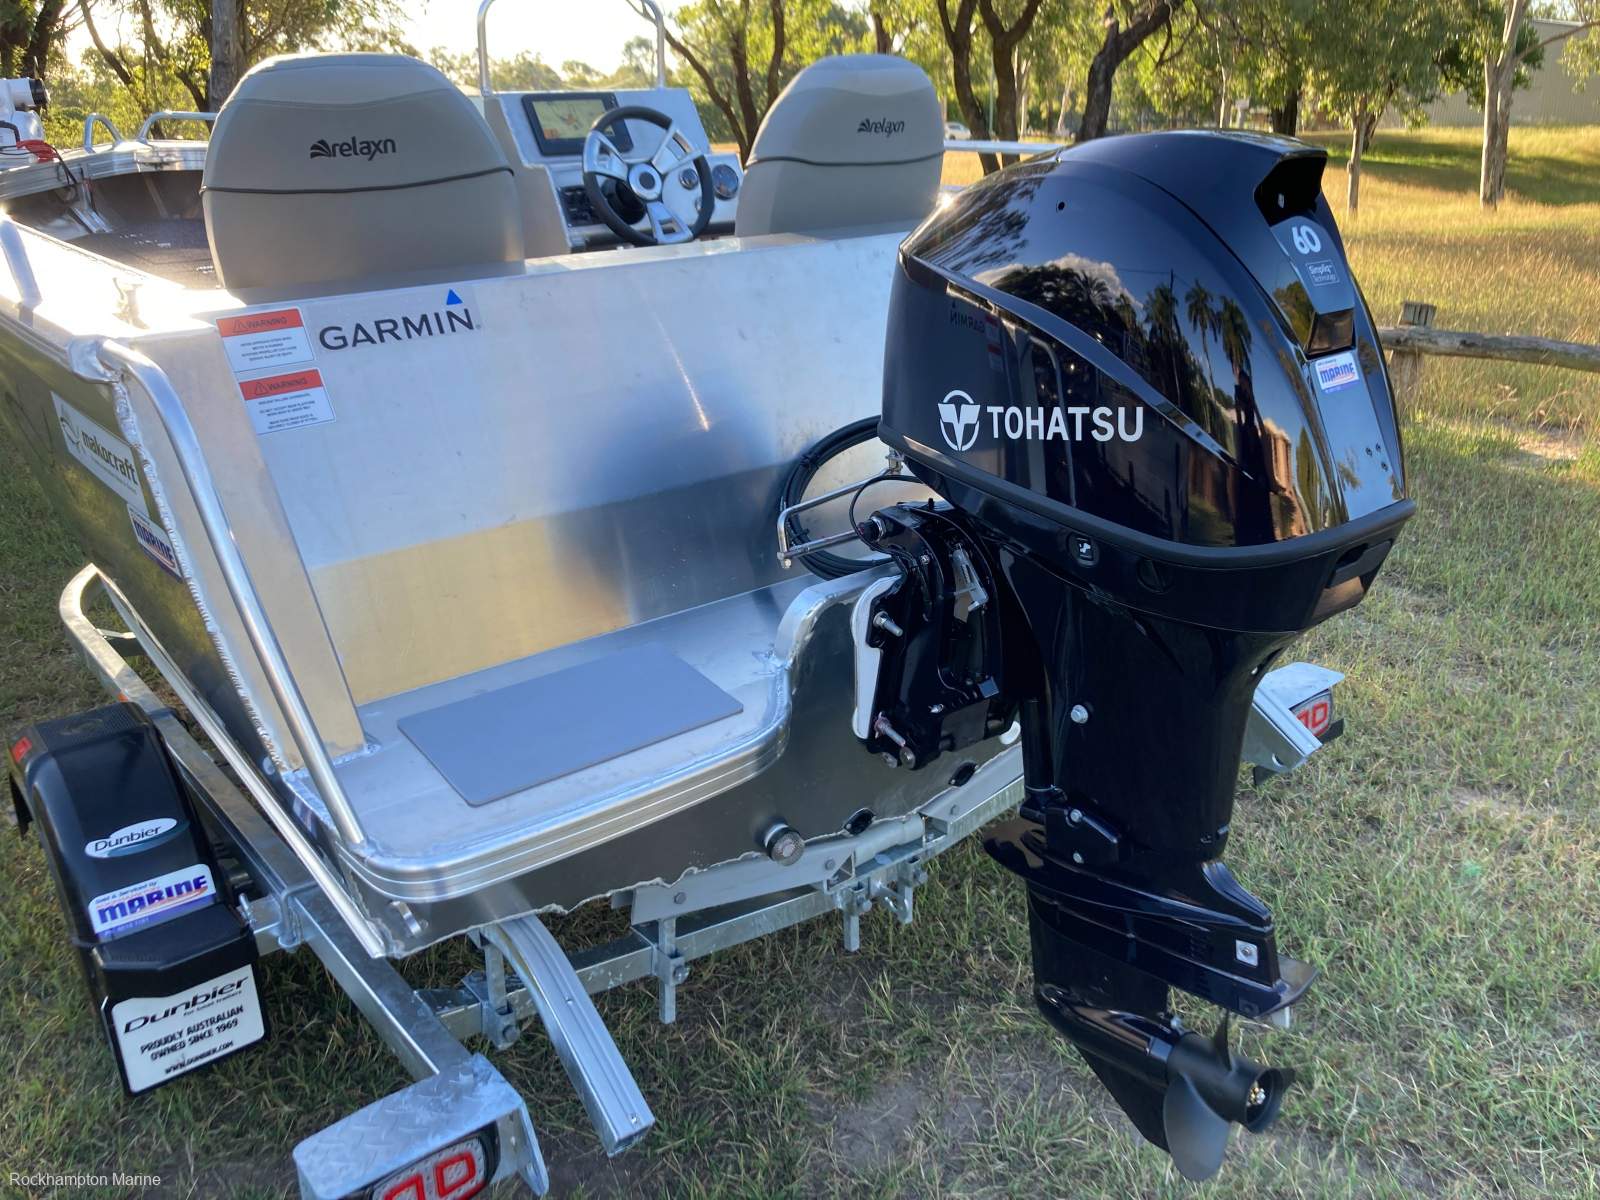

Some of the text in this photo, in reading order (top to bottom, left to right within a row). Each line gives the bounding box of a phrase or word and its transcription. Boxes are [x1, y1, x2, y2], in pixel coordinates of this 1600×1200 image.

[331, 136, 396, 161] relaxn
[1291, 225, 1322, 255] 60
[247, 316, 288, 329] WARNING
[319, 308, 474, 350] GARMIN
[268, 377, 308, 391] WARNING
[986, 406, 1144, 442] TOHATSU
[82, 430, 139, 486] makocraft
[94, 825, 162, 852] Dunbier
[123, 976, 249, 1034] Dunbier
[140, 1004, 244, 1054] PROUDLY AUSTRALIAN
[150, 1018, 238, 1061] OWNED SINCE 1969
